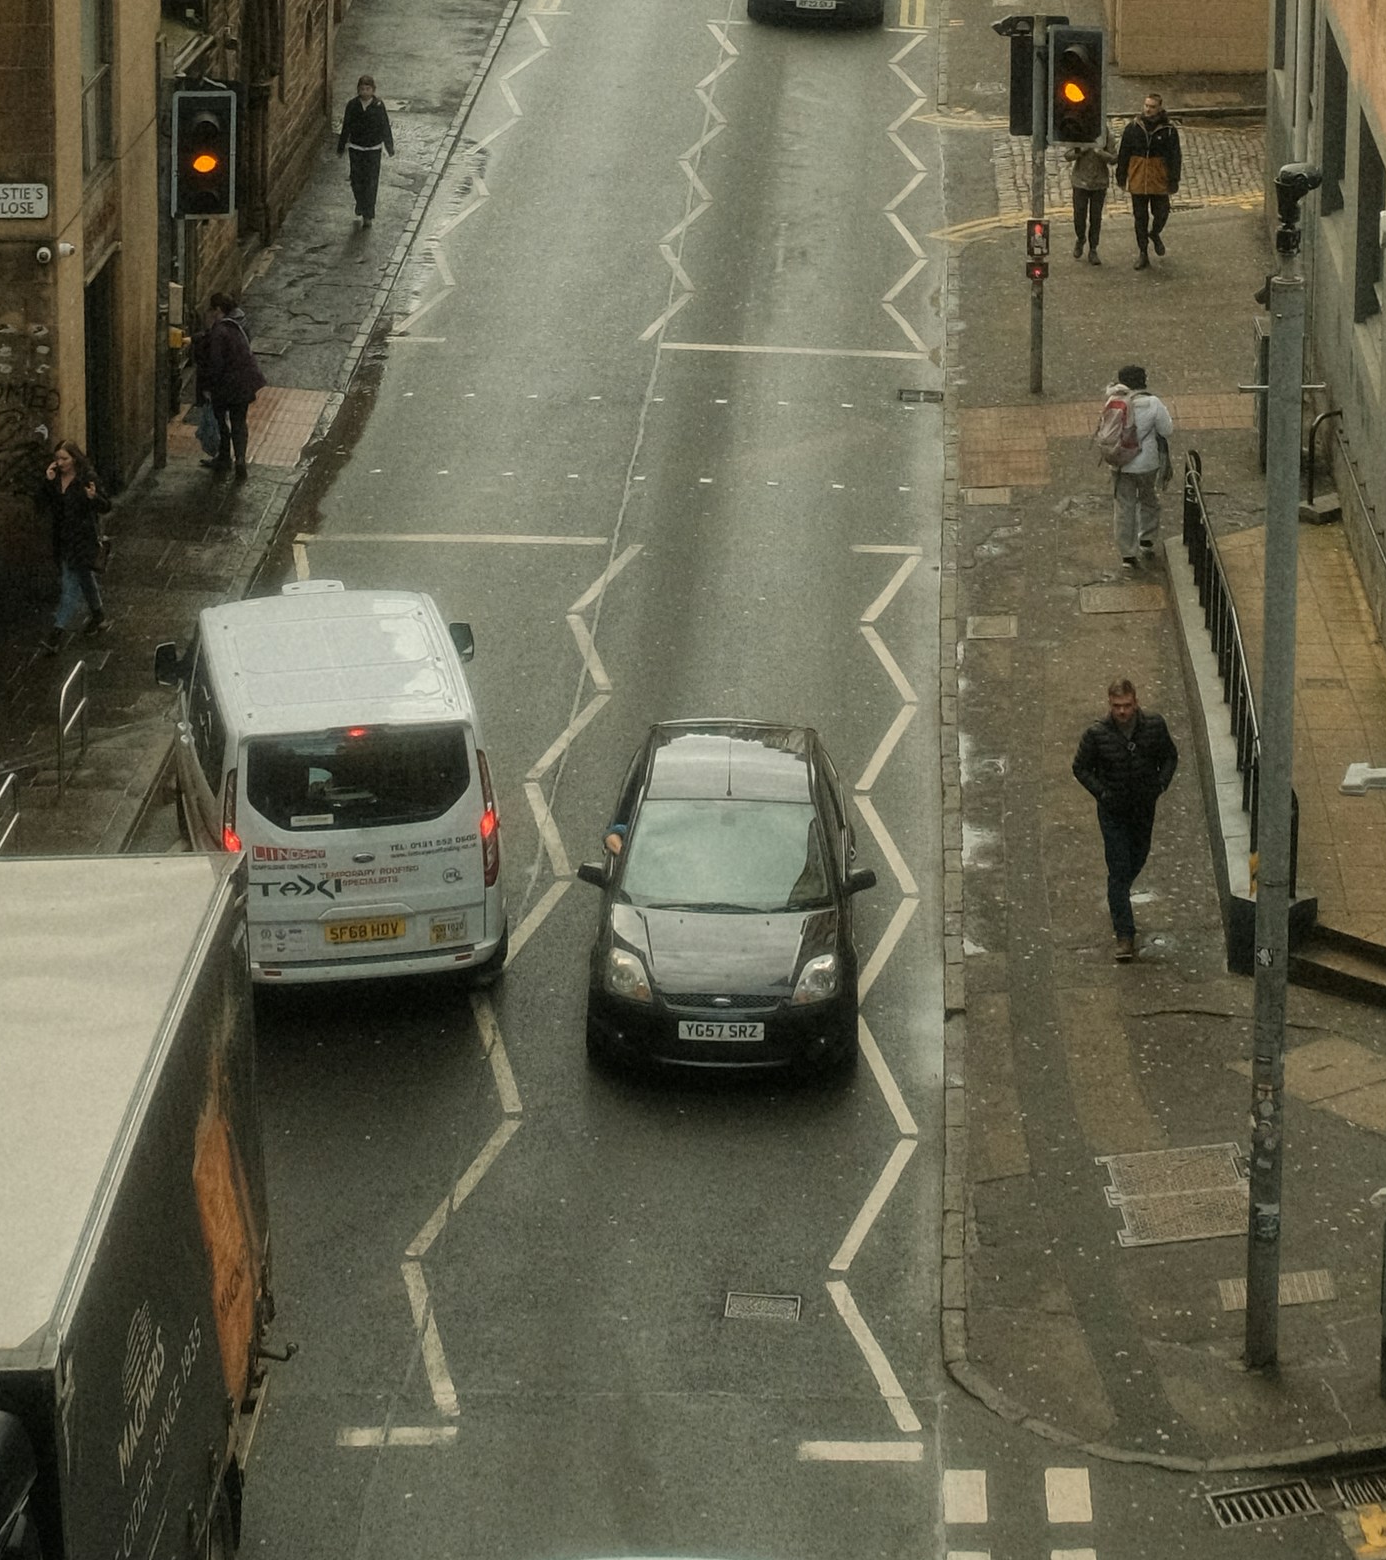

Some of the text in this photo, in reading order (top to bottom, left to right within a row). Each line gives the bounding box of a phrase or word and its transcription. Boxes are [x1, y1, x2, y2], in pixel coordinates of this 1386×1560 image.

[253, 846, 326, 861] LINDSAY
[320, 865, 419, 880] TEMPORARY ROOFING
[249, 874, 342, 900] TAXI
[341, 876, 398, 887] SPECIALISTS
[330, 922, 399, 940] SF68 HDV
[686, 1023, 758, 1038] YG57 SRZ
[118, 1325, 166, 1487] MAGNERS
[123, 1460, 154, 1558] CIDER
[153, 1374, 182, 1469] SINCE
[181, 1316, 202, 1384] 1935
